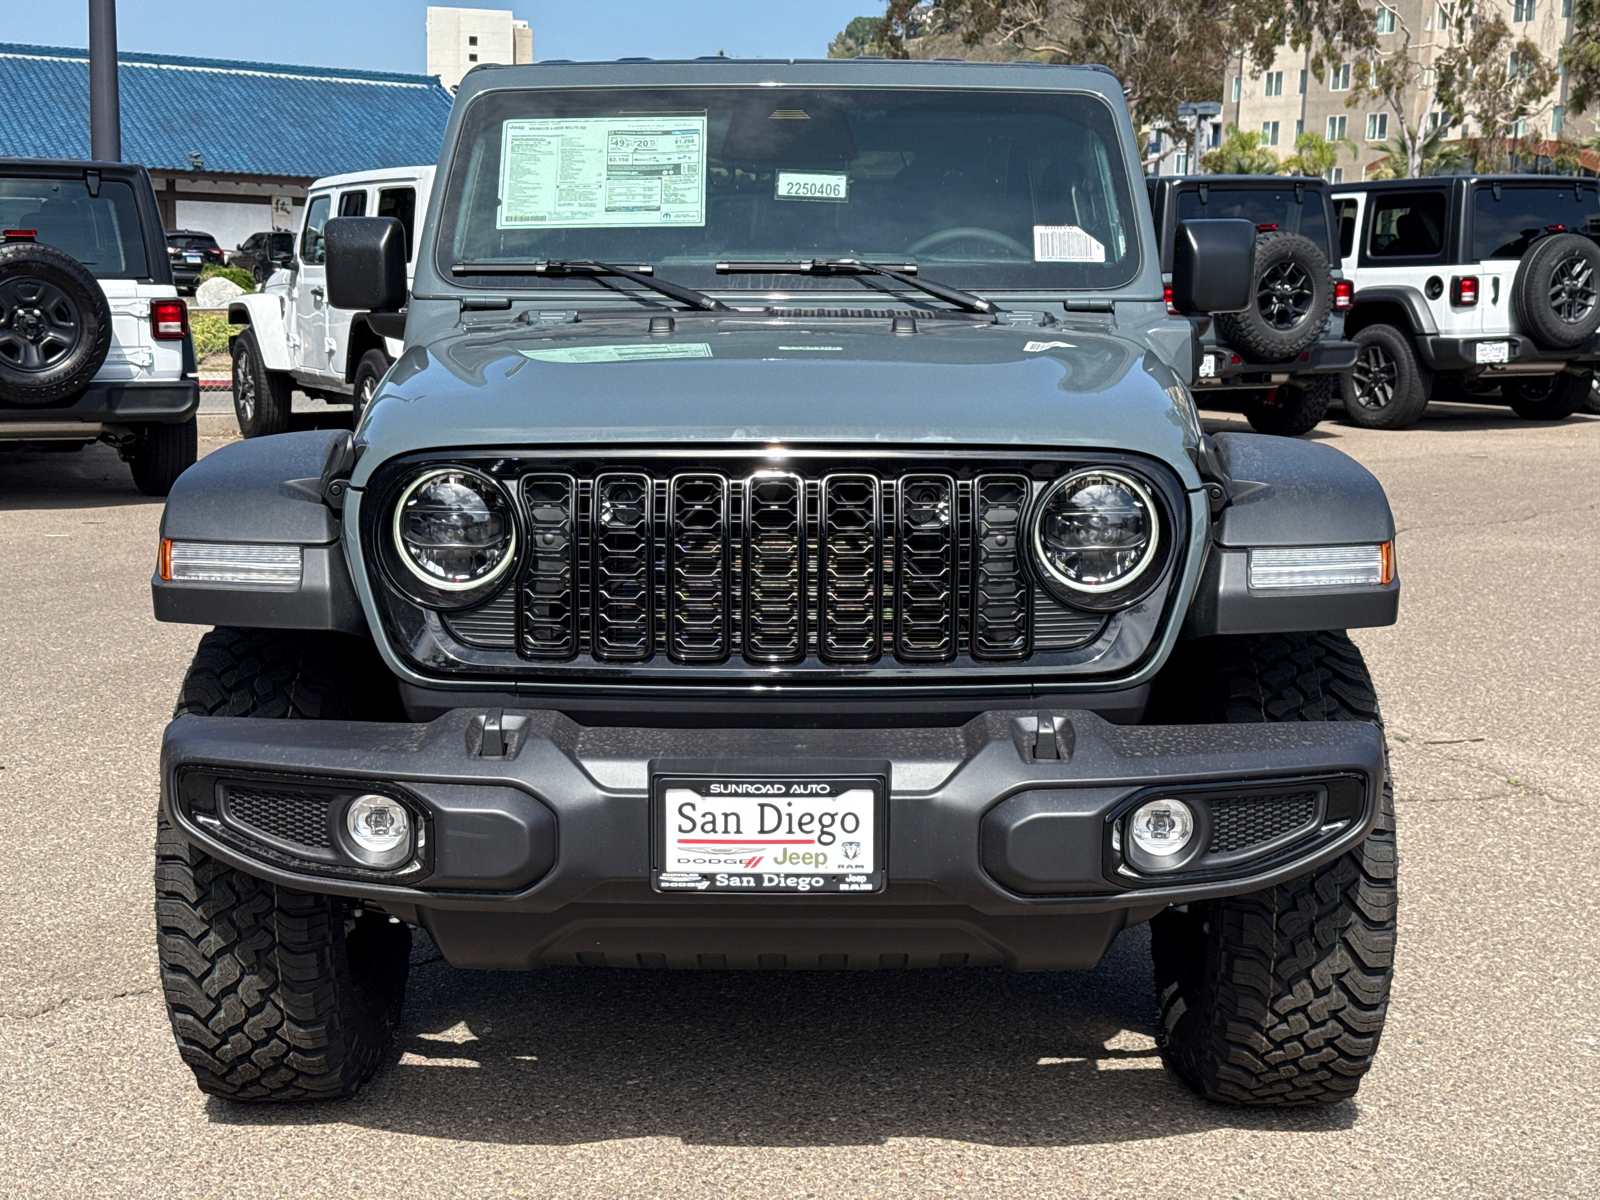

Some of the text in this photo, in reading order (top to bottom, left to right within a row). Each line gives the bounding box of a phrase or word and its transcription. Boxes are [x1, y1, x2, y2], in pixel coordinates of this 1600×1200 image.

[786, 182, 841, 196] 2250406
[709, 783, 830, 794] SUNROAD AUTO
[677, 801, 860, 846] San Diego
[773, 847, 828, 869] Jeep
[715, 873, 825, 891] San Diego
[845, 873, 867, 883] Jeep
